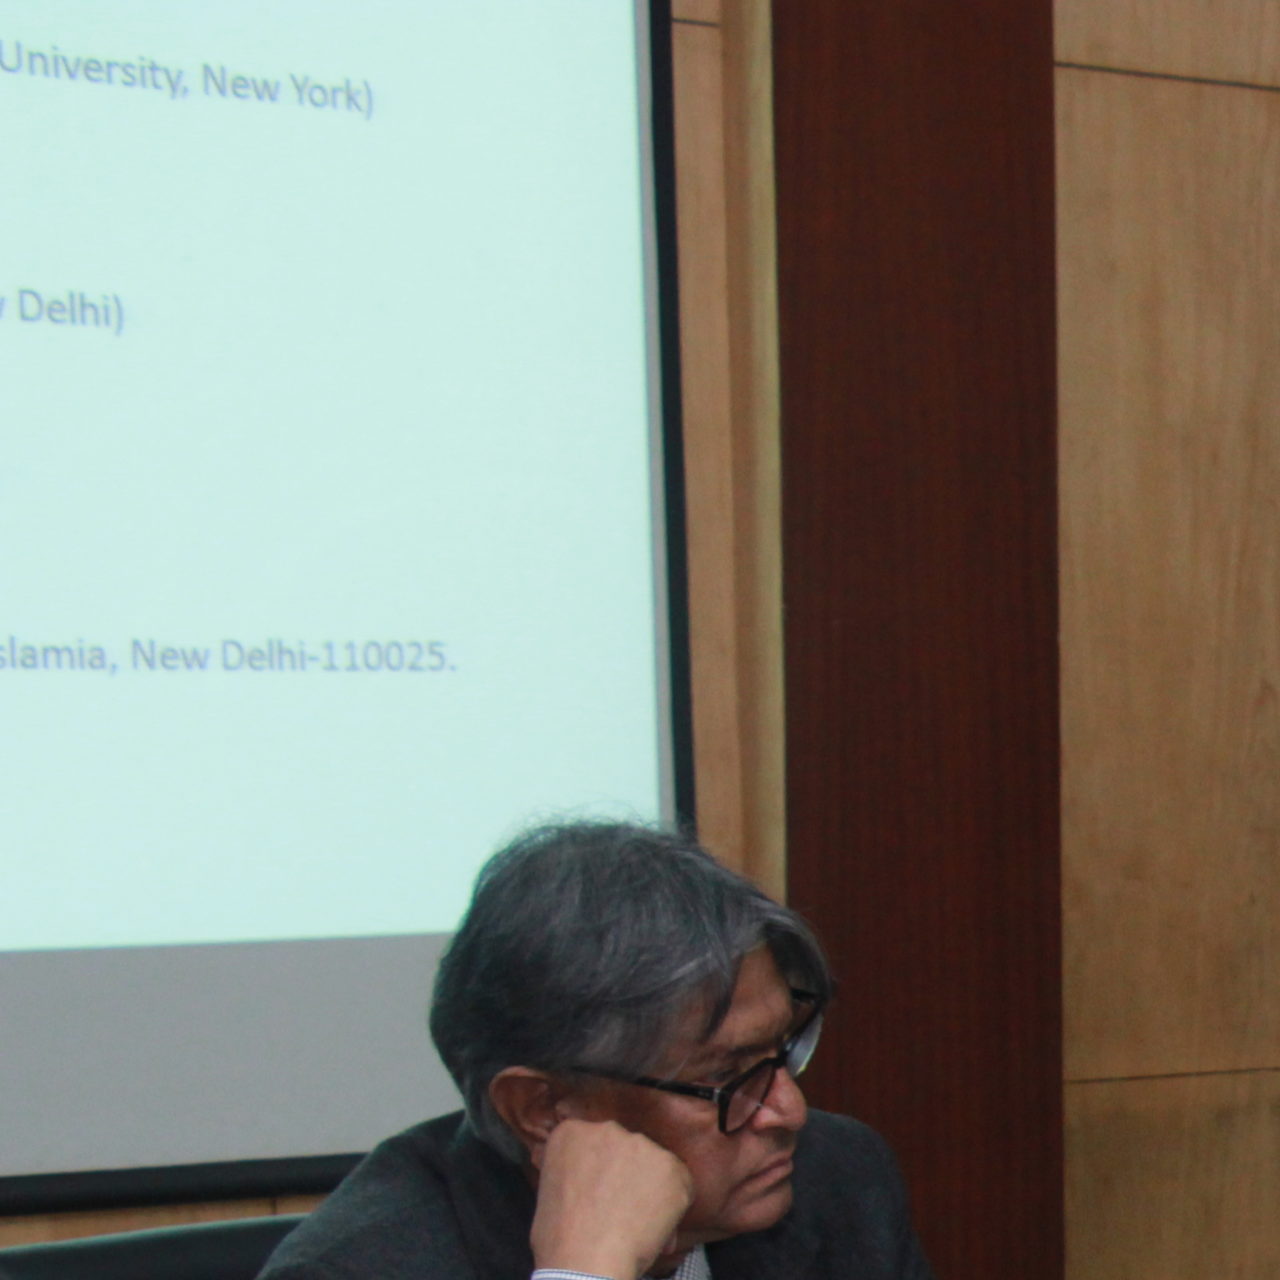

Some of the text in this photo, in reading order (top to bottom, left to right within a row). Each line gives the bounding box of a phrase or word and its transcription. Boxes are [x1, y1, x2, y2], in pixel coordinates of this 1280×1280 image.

[0, 40, 374, 121] University, New York)
[17, 288, 126, 337] Delhi)
[0, 636, 457, 676] slamia, New Delhi-110025.
